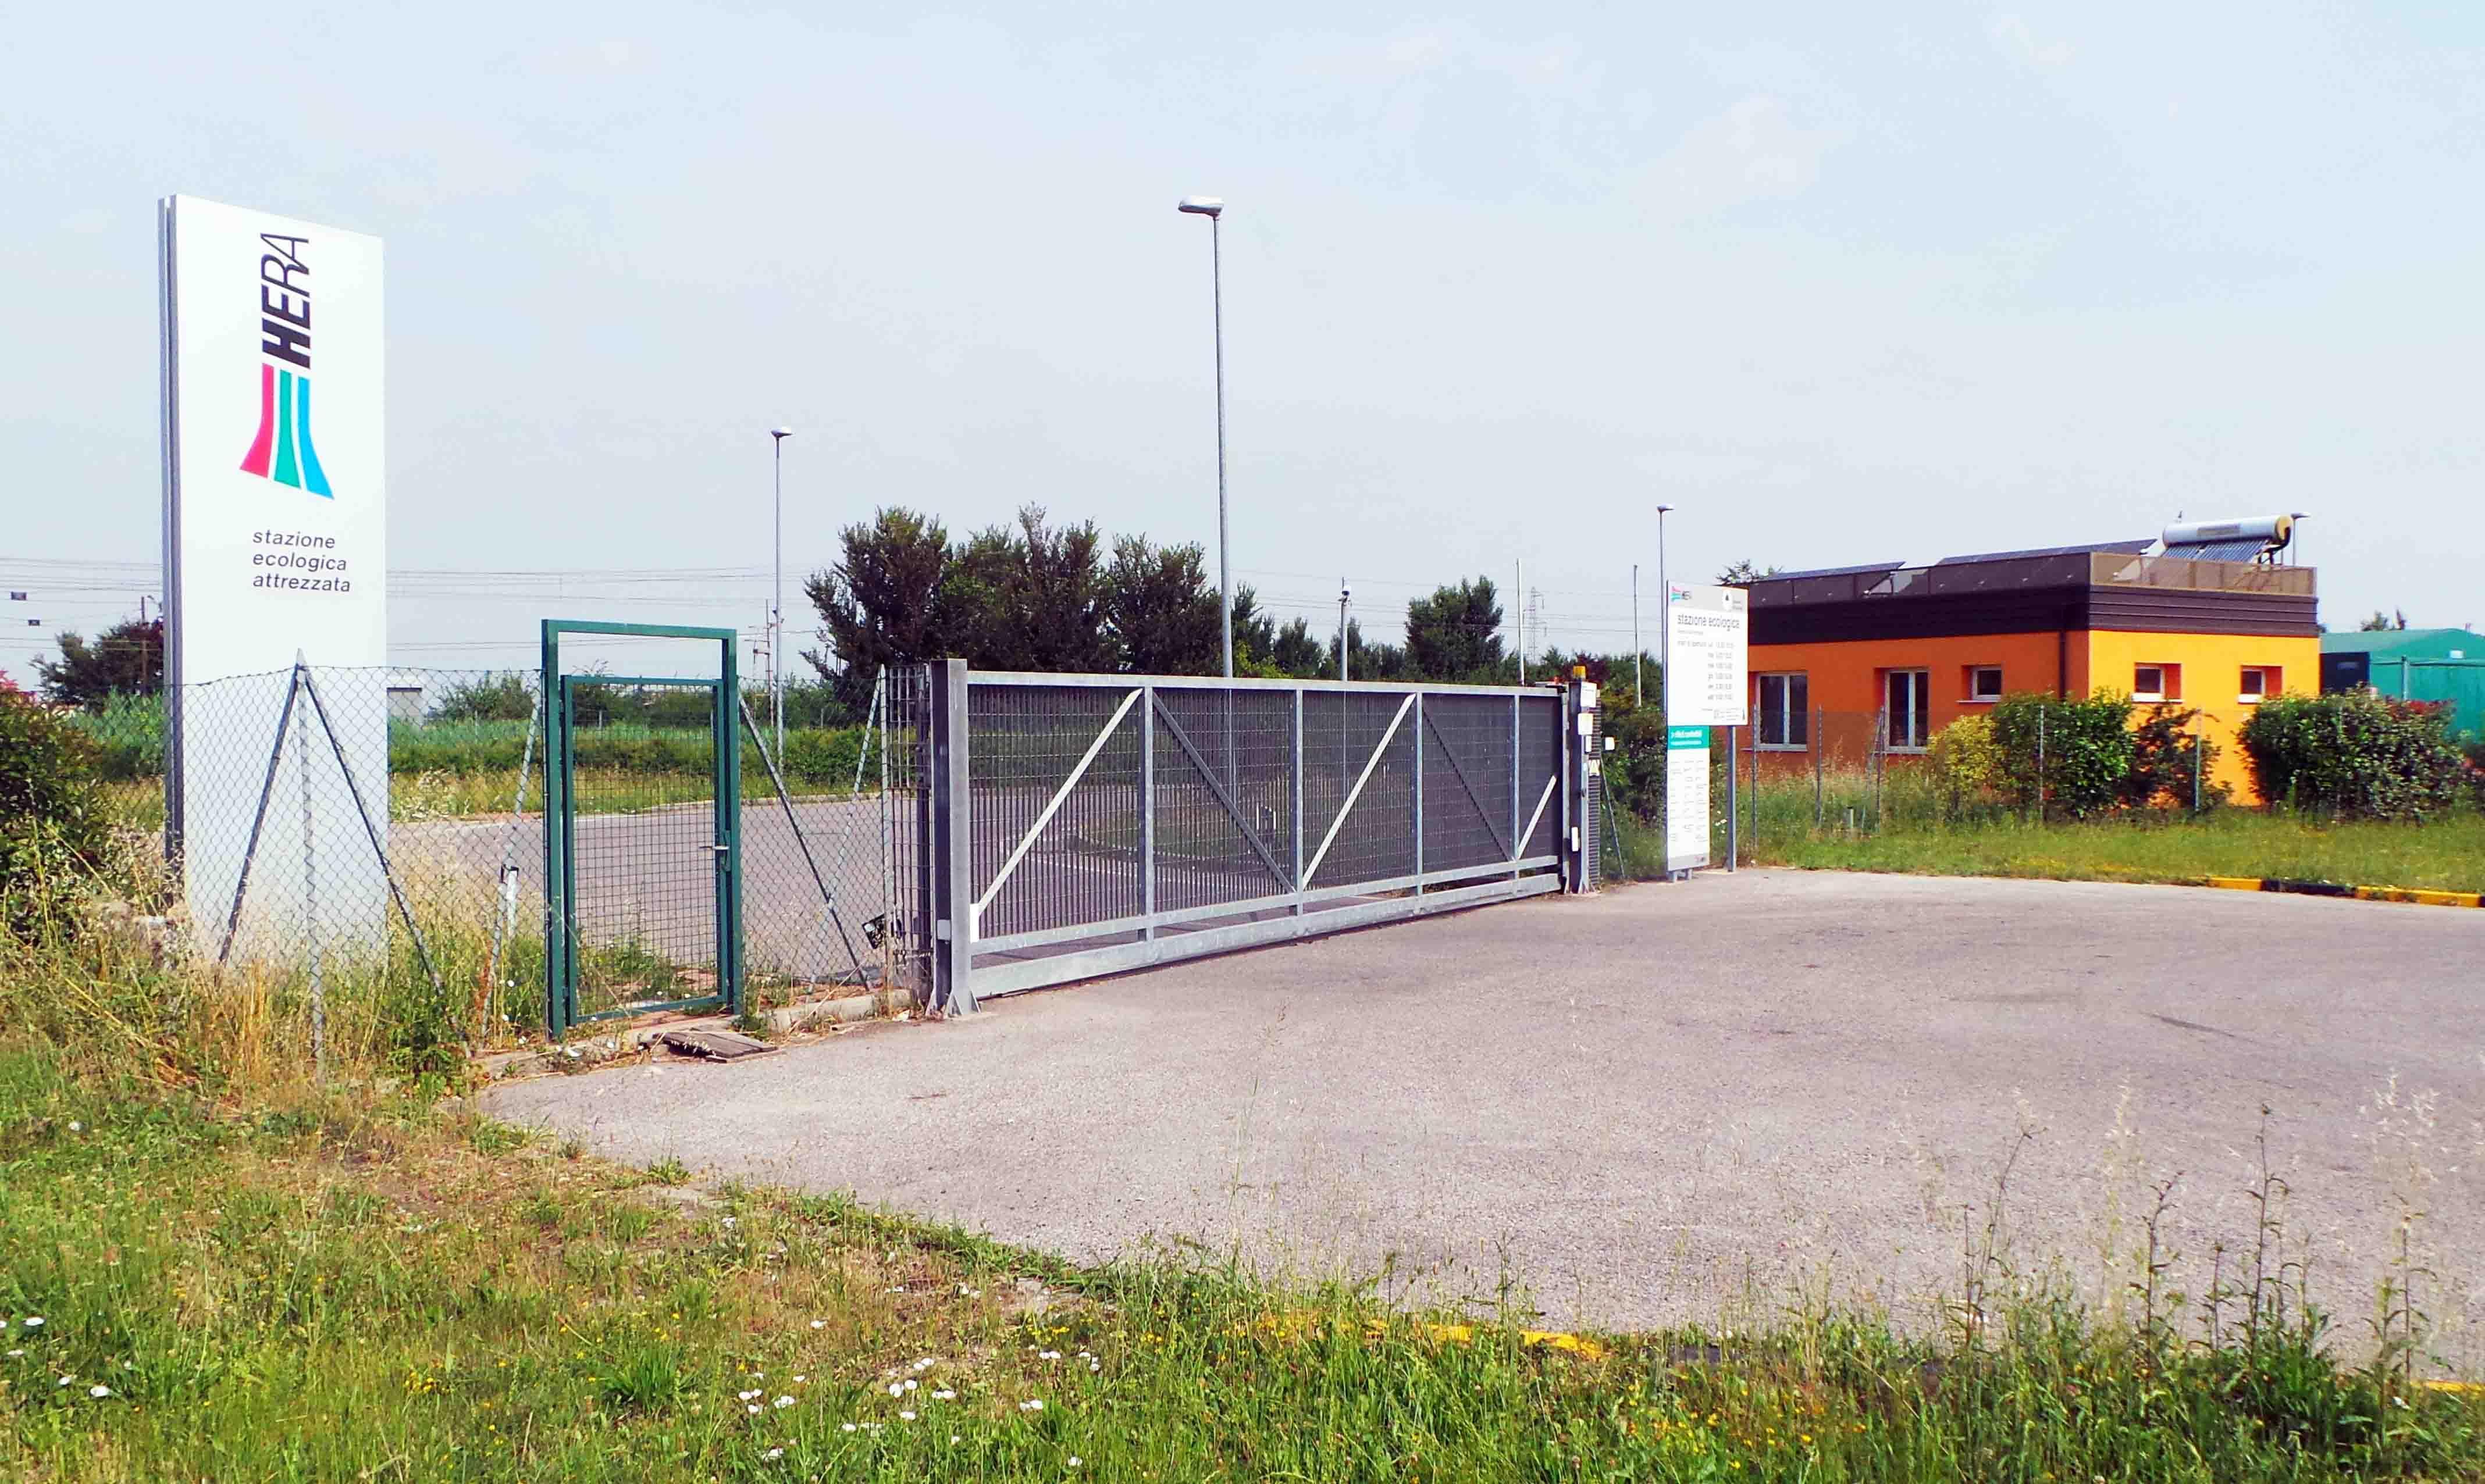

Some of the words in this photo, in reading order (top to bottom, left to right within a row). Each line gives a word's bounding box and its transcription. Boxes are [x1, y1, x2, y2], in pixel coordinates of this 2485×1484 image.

[260, 233, 311, 369] HERA
[253, 530, 335, 549] stazione
[253, 552, 347, 572] ecologica
[253, 573, 350, 592] attrezzata
[1678, 614, 1707, 626] stazione
[1708, 615, 1740, 632] ecologica
